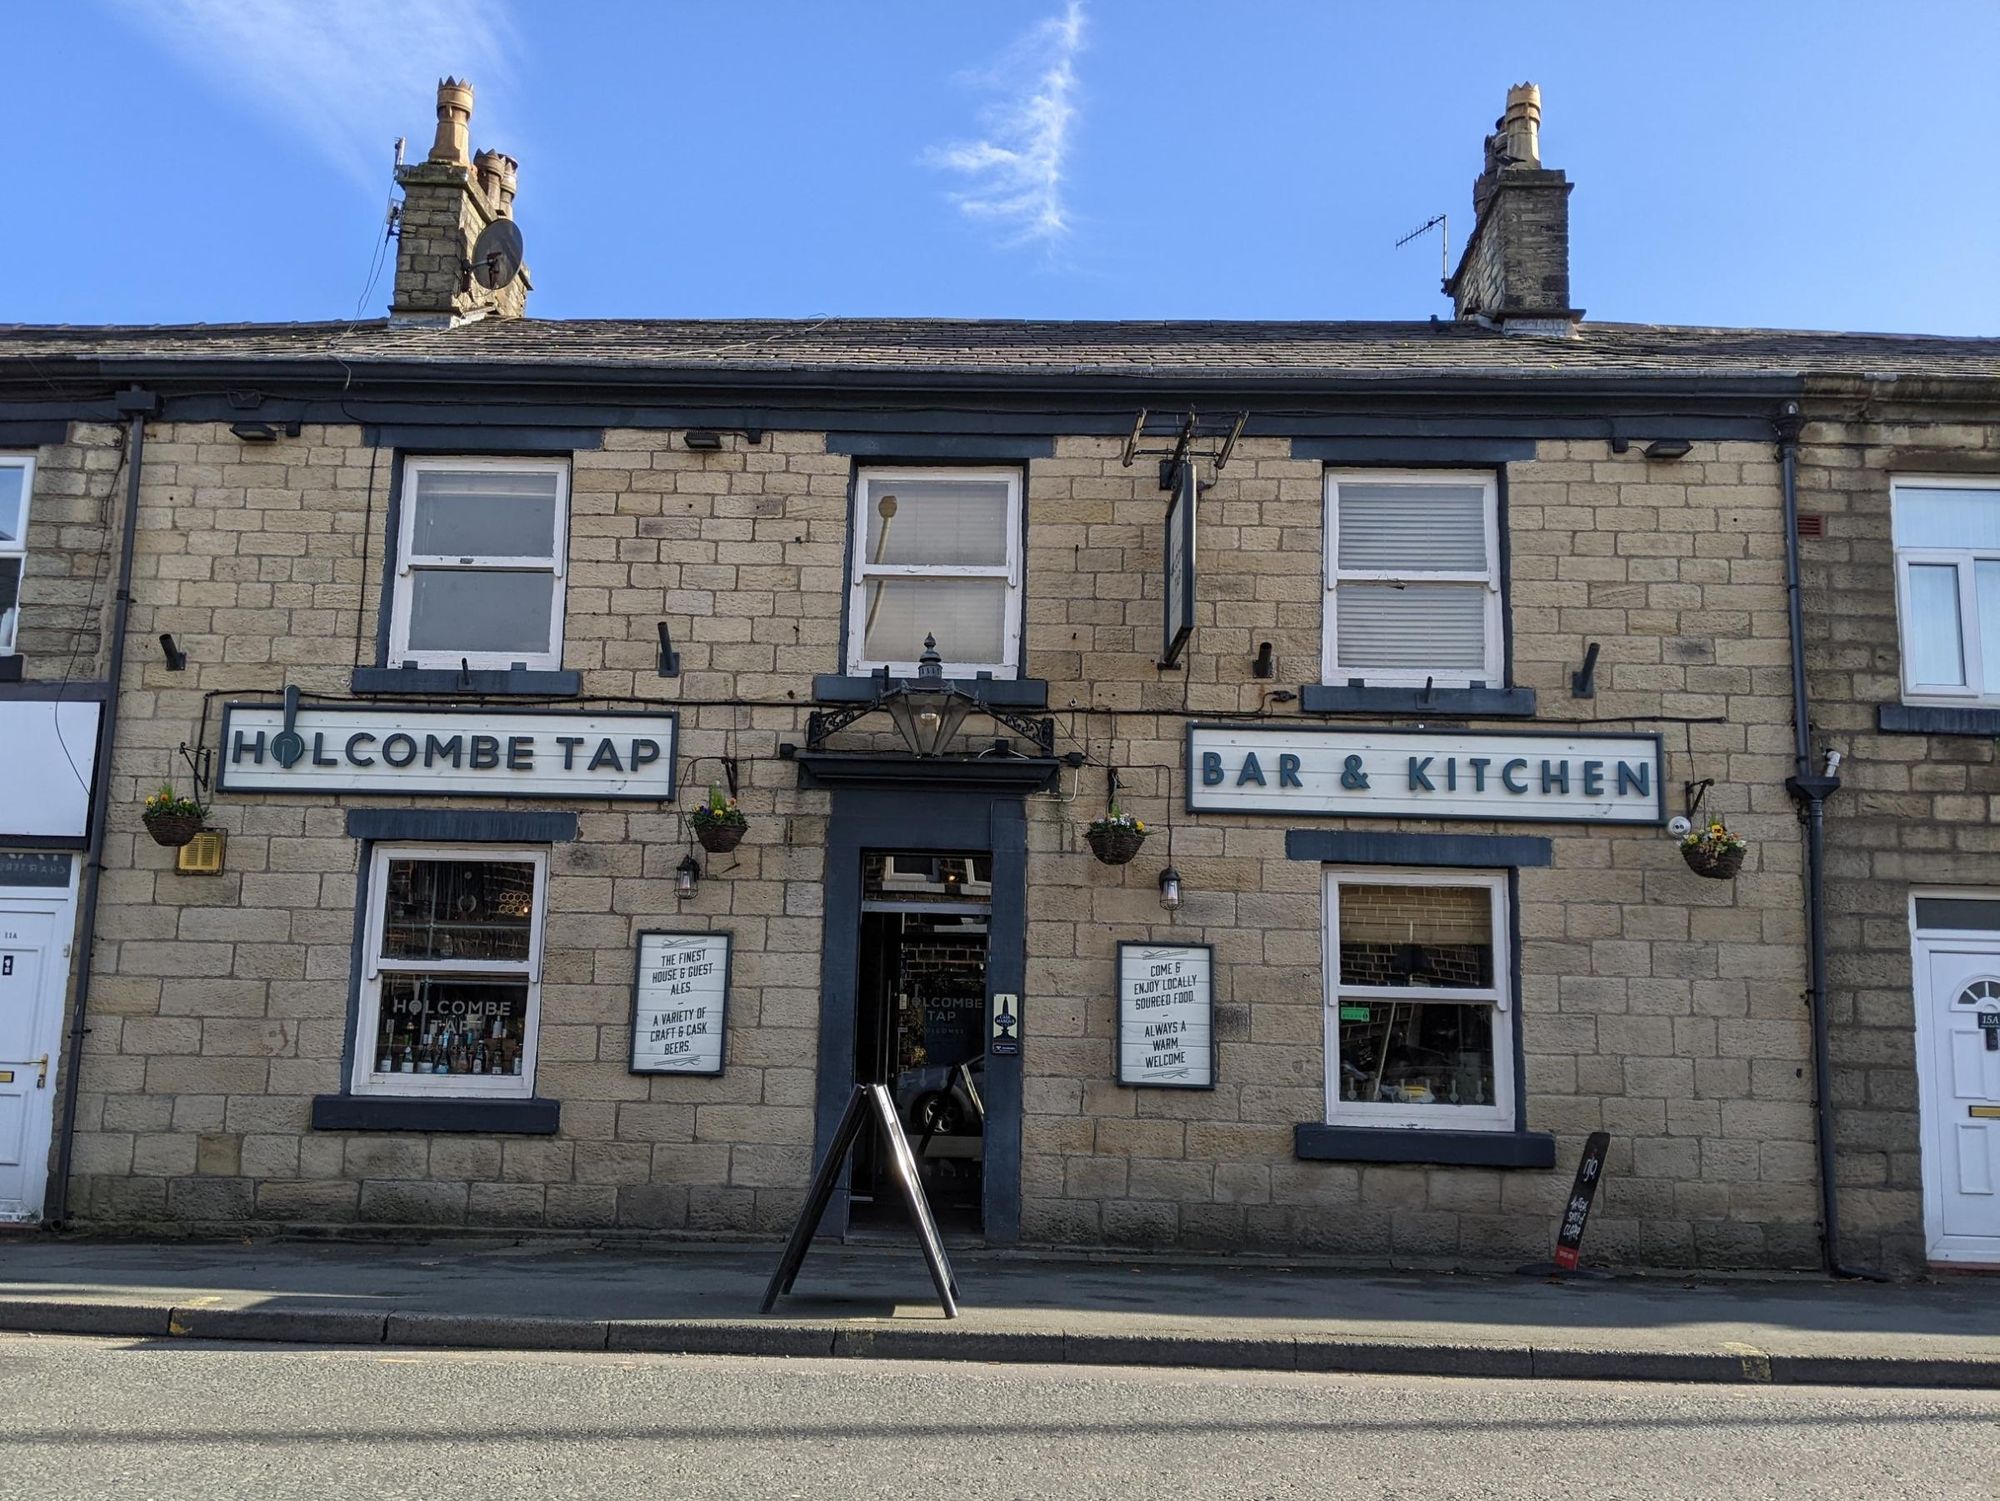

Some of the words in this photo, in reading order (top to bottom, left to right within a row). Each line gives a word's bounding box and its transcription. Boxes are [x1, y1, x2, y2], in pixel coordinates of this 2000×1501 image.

[232, 730, 534, 770] HOLCOMBE
[556, 736, 660, 772] TAP
[1203, 752, 1303, 788] BAR
[1341, 754, 1371, 790] &
[1408, 756, 1650, 796] KITCHEN
[661, 954, 676, 967] THE
[679, 949, 707, 965] FINEST
[652, 968, 678, 983] HOUSE
[680, 967, 685, 979] &
[688, 962, 714, 978] GUEST
[1151, 963, 1173, 977] COME
[1175, 962, 1181, 973] &
[670, 982, 693, 996] ALES.
[1134, 980, 1161, 995] ENJOY
[1162, 974, 1198, 991] LOCALLY
[393, 1000, 512, 1016] HOLCOMBE
[1135, 994, 1171, 1010] SOURCED
[652, 1015, 659, 1027] A
[661, 1009, 695, 1025] VARIETY
[696, 1007, 707, 1019] OF
[927, 1010, 956, 1021] TAP
[1983, 1015, 1999, 1025] 15A
[650, 1027, 676, 1042] CRAFT
[678, 1026, 684, 1038] &
[686, 1022, 708, 1036] CASK
[1144, 1022, 1178, 1038] ALWAYS
[1181, 1020, 1186, 1032] A
[664, 1040, 691, 1055] BEERS.
[1152, 1037, 1179, 1052] WARM
[1145, 1051, 1186, 1068] WELCOME
